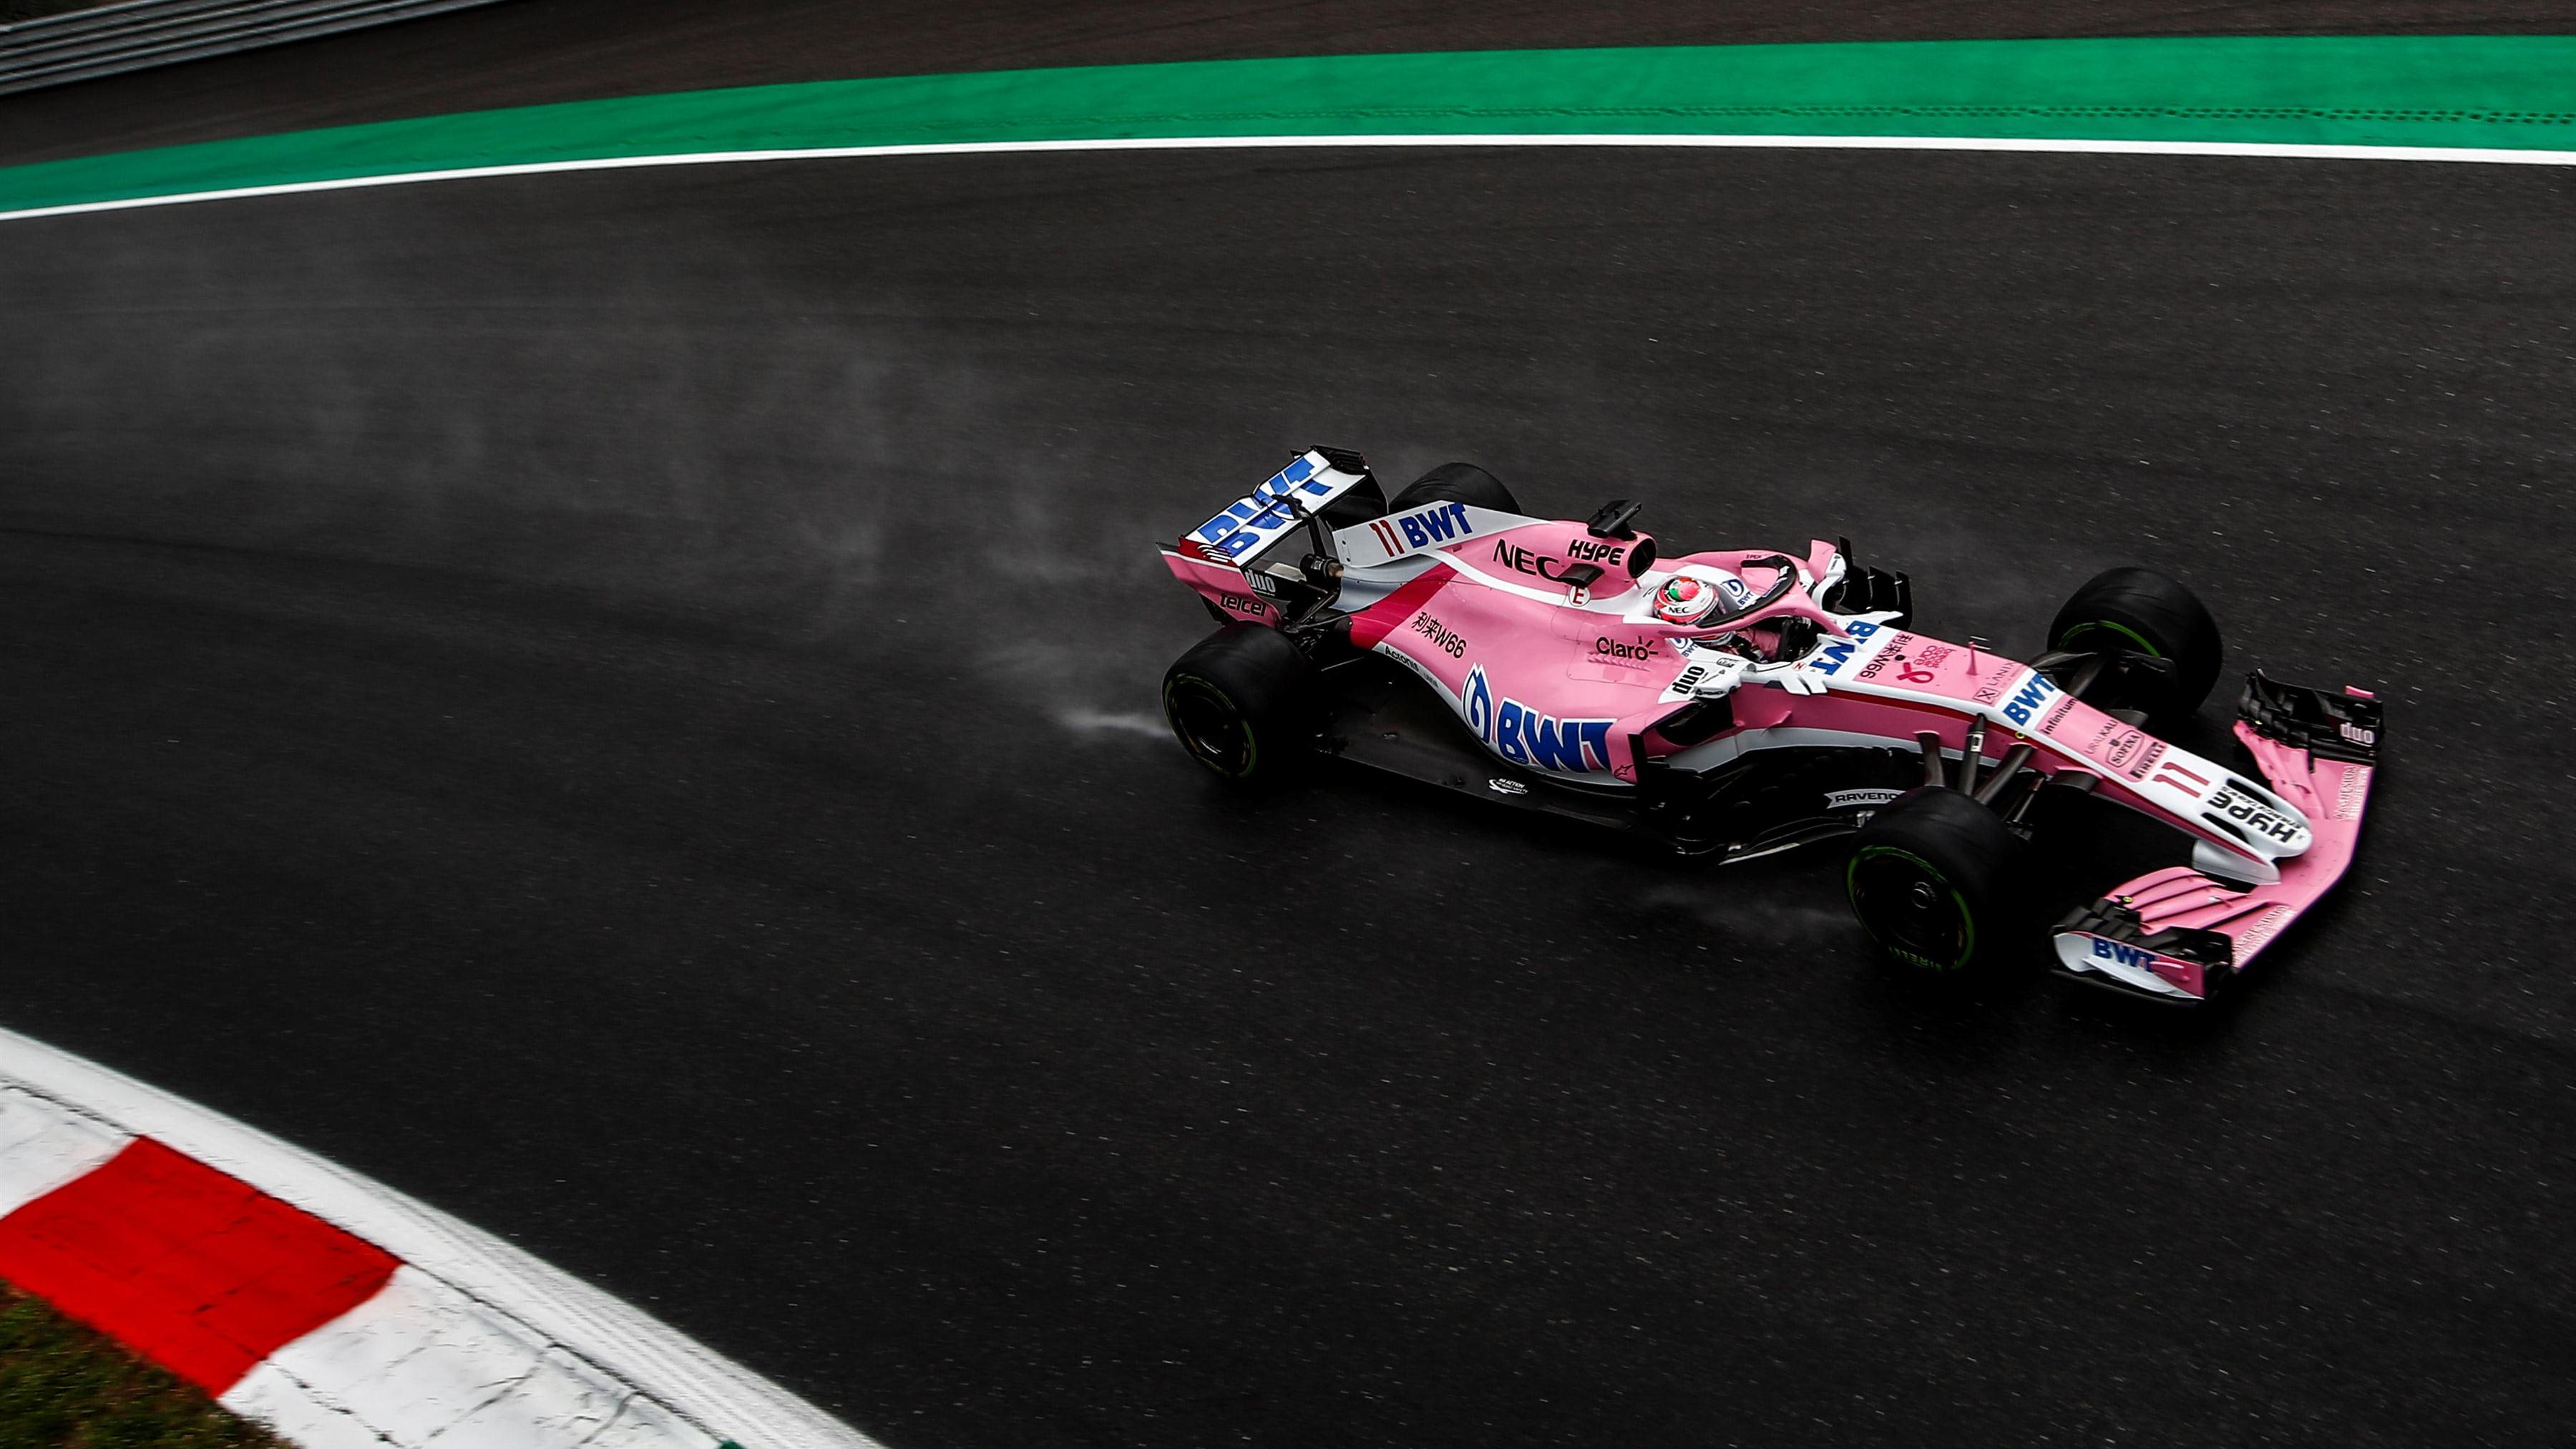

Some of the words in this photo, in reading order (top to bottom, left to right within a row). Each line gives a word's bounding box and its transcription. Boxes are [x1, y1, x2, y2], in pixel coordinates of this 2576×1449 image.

[1370, 519, 1405, 557] 11
[1398, 502, 1473, 549] BWT
[1493, 538, 1563, 583] NEC
[1567, 538, 1626, 567] HYPE
[1244, 568, 1276, 593] duo
[1221, 593, 1266, 616] telcel
[1573, 589, 1585, 605] E
[1596, 636, 1648, 661] Claro
[1672, 665, 1705, 695] duo
[2003, 673, 2056, 727] BWT
[1498, 701, 1614, 774] BWT
[2340, 722, 2375, 743] duo
[2111, 734, 2140, 764] SOFINA
[2152, 761, 2211, 799] 11
[1835, 792, 1899, 802] RAVENO
[2207, 791, 2301, 843] HYPE
[2093, 937, 2157, 972] BWT
